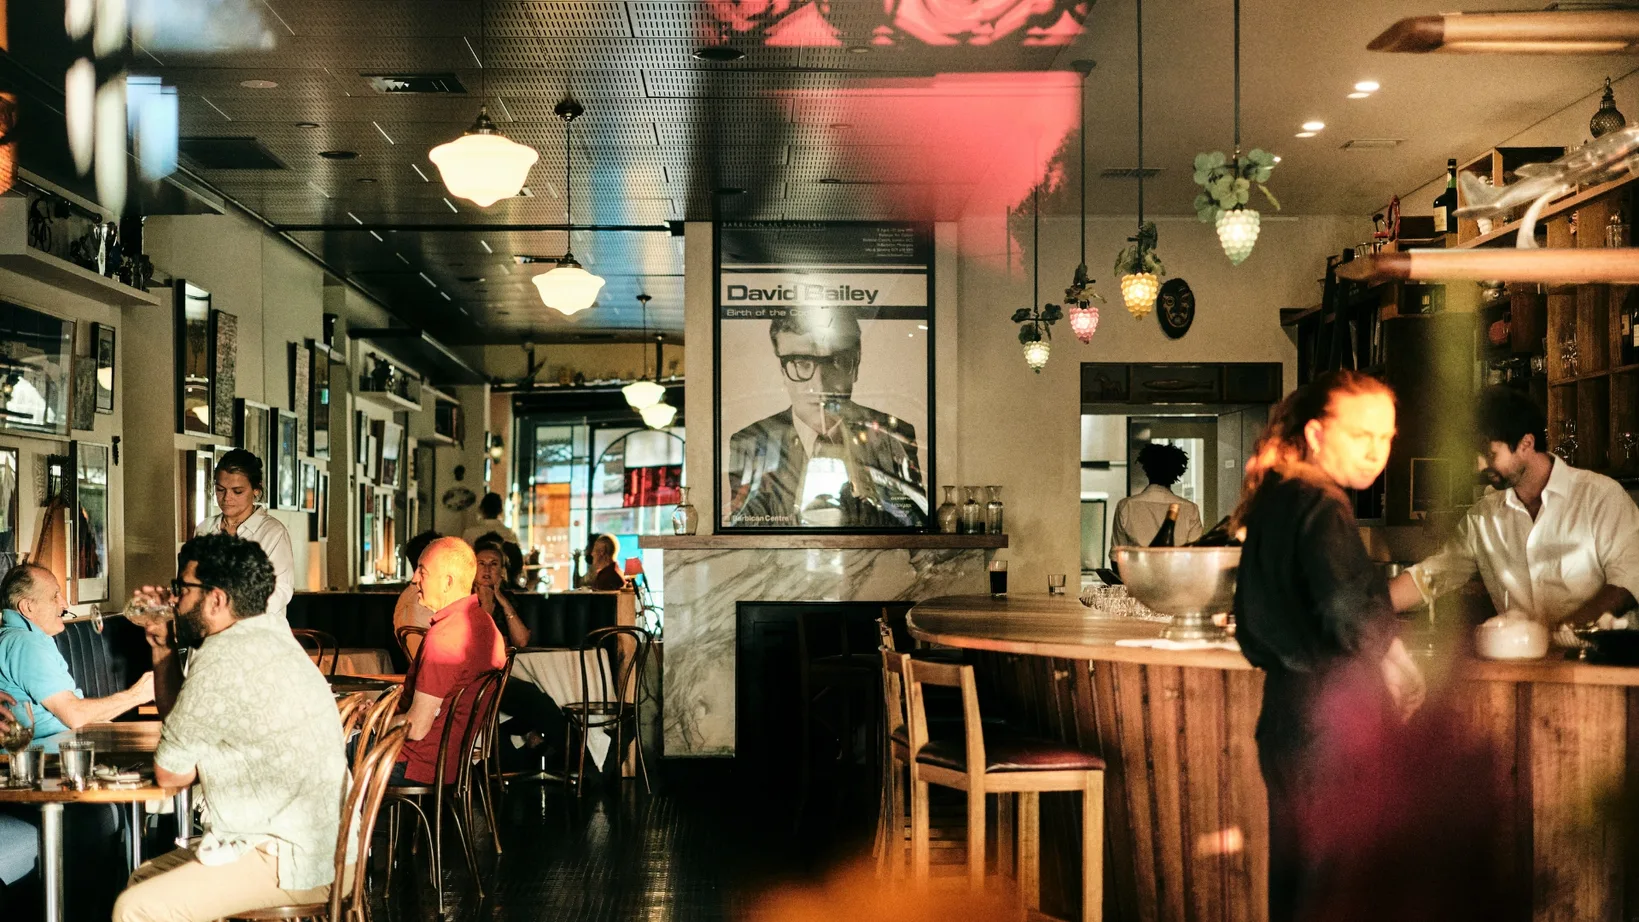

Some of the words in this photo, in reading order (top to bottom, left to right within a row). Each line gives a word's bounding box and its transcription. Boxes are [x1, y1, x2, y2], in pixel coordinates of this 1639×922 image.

[727, 285, 798, 301] David
[804, 285, 879, 304] Bailey
[726, 309, 752, 317] Birth
[755, 309, 767, 317] of
[769, 309, 787, 317] the
[732, 514, 764, 522] Barbican
[764, 514, 789, 522] Centre
